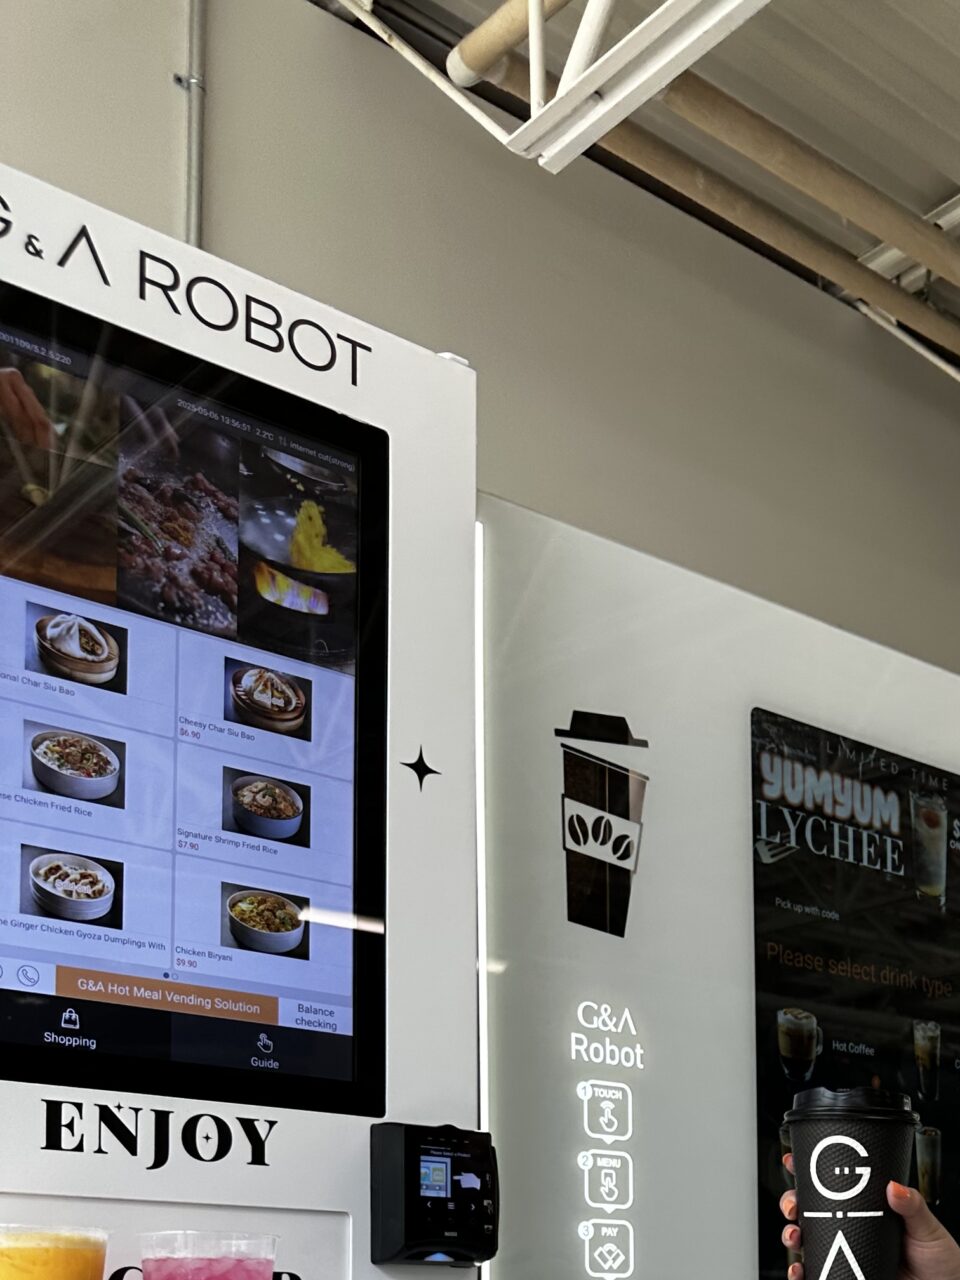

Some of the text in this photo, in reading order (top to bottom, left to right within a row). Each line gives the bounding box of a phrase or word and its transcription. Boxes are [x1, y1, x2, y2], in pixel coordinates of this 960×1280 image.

[139, 249, 373, 387] ROBOT
[21, 676, 41, 688] Char
[58, 685, 75, 696] Bao
[179, 716, 255, 741] Cheesy Char Siu Bao
[180, 727, 200, 740] $6.90
[911, 767, 949, 790] TIME
[759, 751, 901, 836] YUMYUM
[14, 794, 49, 808] Chicken
[50, 801, 72, 813] Fried
[74, 806, 93, 817] Rice
[177, 828, 278, 855] Signature Shrimp Fried Rice
[178, 840, 199, 851] $7.90
[756, 799, 905, 877] LYCHEE
[775, 896, 840, 921] Pick up with code
[10, 919, 38, 931] Ginger
[40, 924, 74, 937] Chicken
[76, 929, 102, 942] Gyoza
[103, 934, 146, 949] Dumplings
[148, 941, 166, 951] With
[175, 945, 233, 962] Chicken Biryani
[176, 958, 198, 969] $9.90
[766, 942, 953, 1000] Please select drink type
[78, 978, 261, 1014] G&A Hot Meal Vending Solution
[297, 1003, 335, 1018] Balance
[295, 1016, 338, 1033] checking
[43, 1031, 97, 1050] Shopping
[570, 1031, 645, 1070] Robot
[832, 1039, 875, 1056] Hot Coffee
[250, 1056, 280, 1070] Guide
[594, 1087, 623, 1100] TOUCH
[40, 1098, 278, 1170] ENJOY
[597, 1157, 622, 1169] MENU
[601, 1227, 619, 1238] PAY
